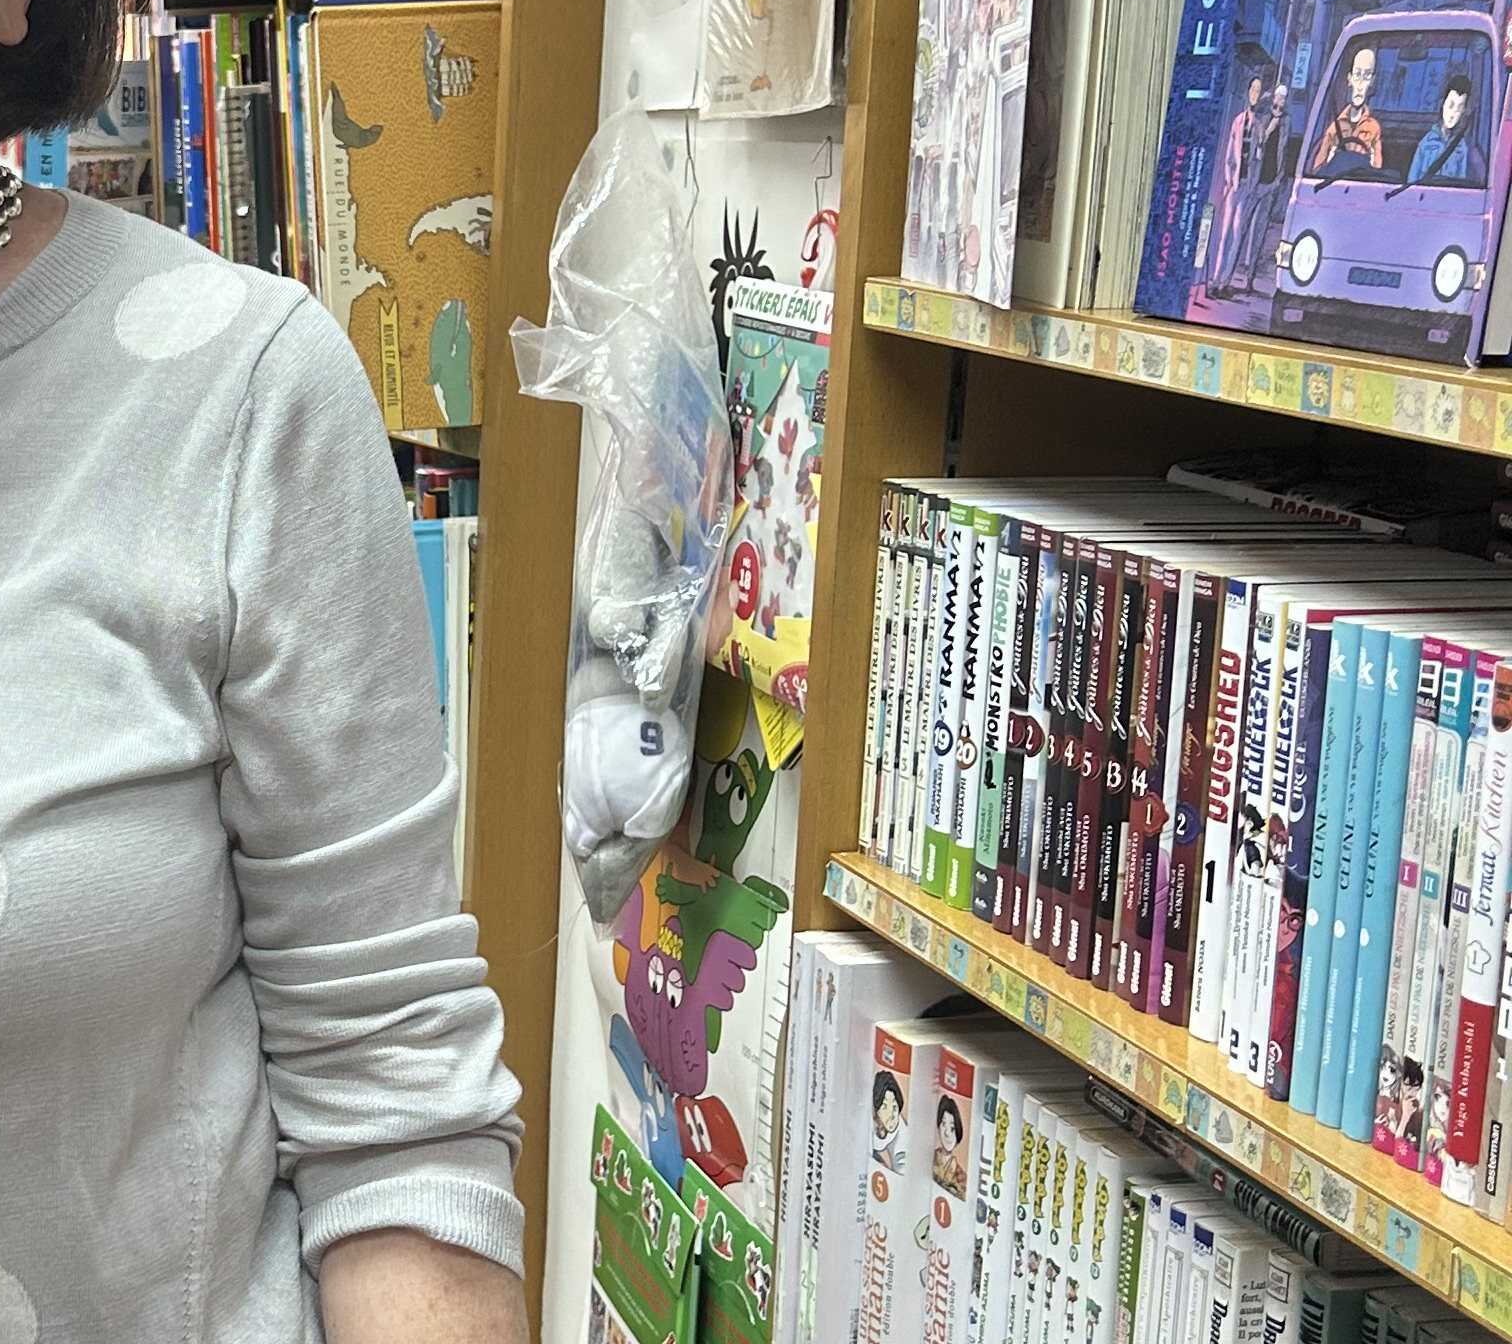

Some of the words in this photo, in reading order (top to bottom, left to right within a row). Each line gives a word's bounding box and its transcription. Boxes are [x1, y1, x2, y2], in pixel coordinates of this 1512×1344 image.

[334, 157, 345, 187] RUE
[336, 198, 346, 219] DU
[338, 229, 351, 286] MONDE
[735, 282, 788, 316] STICKERS
[874, 556, 885, 611] LIVRES
[894, 561, 904, 619] LIVRES
[911, 566, 923, 623] LIVRES
[929, 573, 939, 632] LIVRES
[941, 565, 960, 689] RANMA
[962, 575, 985, 702] RANMA
[934, 726, 948, 749] 19
[1008, 720, 1015, 744] 1
[1025, 726, 1033, 751] 2
[1048, 735, 1055, 759] 3
[956, 741, 975, 764] 20
[1064, 740, 1074, 767] 4
[1081, 752, 1093, 777] 5
[1107, 761, 1122, 788] 13
[1131, 766, 1148, 796] 14
[1145, 803, 1152, 825] 1
[1479, 750, 1507, 852] Kitchen
[1175, 812, 1186, 836] 2
[1205, 859, 1216, 904] 1
[1230, 1027, 1239, 1060] 2
[1249, 1040, 1259, 1073] 3
[780, 1109, 793, 1223] HIRAYASUMI
[1485, 1122, 1501, 1194] casterman
[803, 1122, 816, 1239] HIRAYASUMI
[811, 1133, 825, 1250] HIRAYASUMI
[876, 1179, 884, 1196] 5
[939, 1202, 946, 1223] 1
